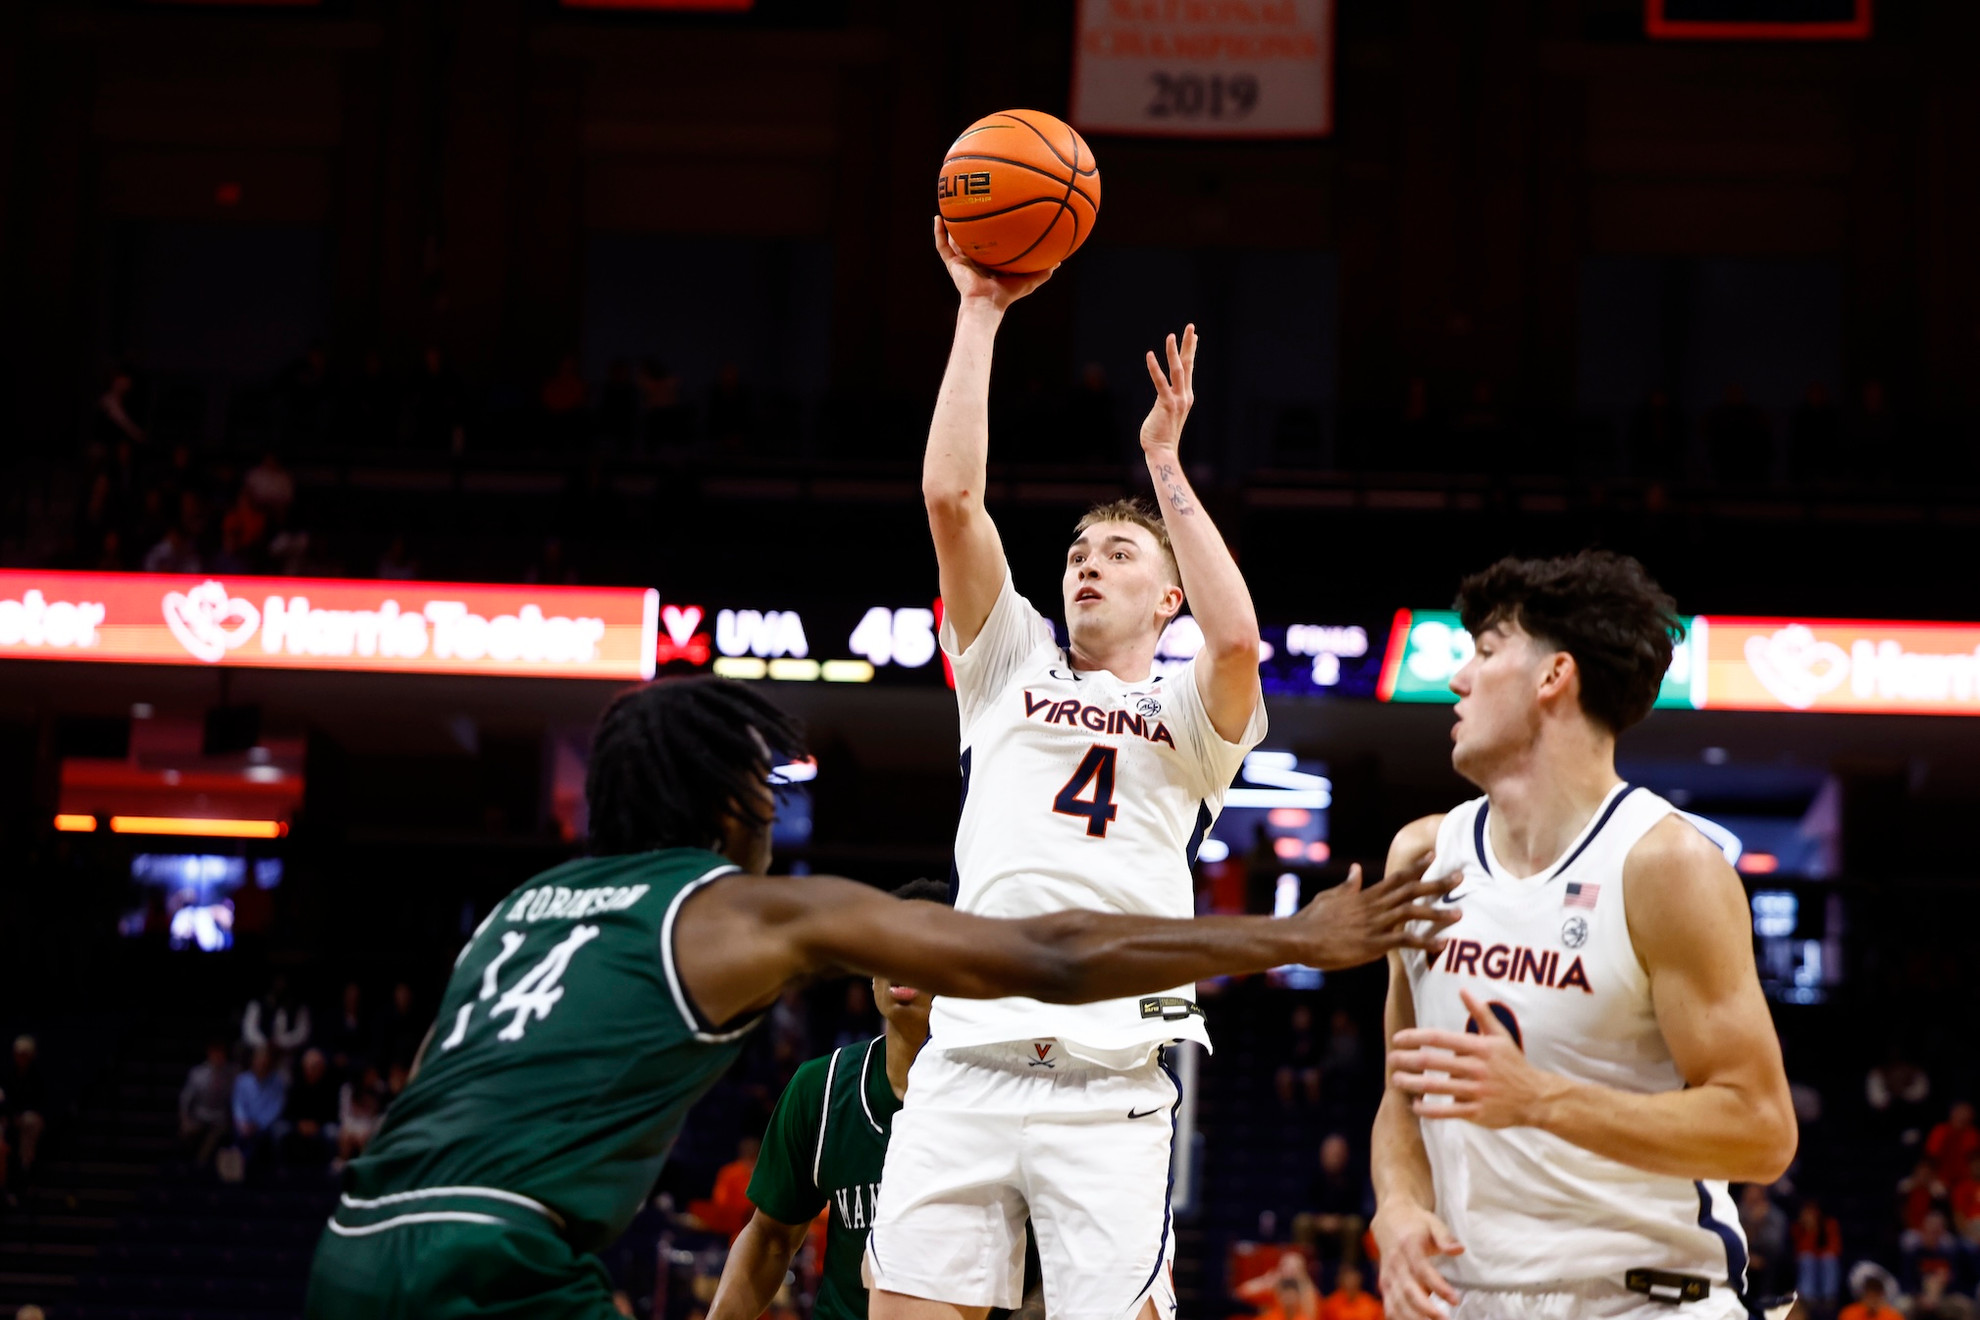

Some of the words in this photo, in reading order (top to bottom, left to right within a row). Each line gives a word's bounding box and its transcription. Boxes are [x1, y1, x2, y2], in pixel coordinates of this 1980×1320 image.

[1147, 71, 1260, 119] 2019
[261, 595, 429, 656] Harris
[426, 600, 604, 662] Teeter
[716, 608, 809, 658] UVA
[848, 606, 936, 668] 45
[1024, 690, 1176, 751] VIRGINIA
[1052, 743, 1118, 838] 4
[505, 884, 650, 922] ROBINSON
[441, 924, 600, 1051] 14
